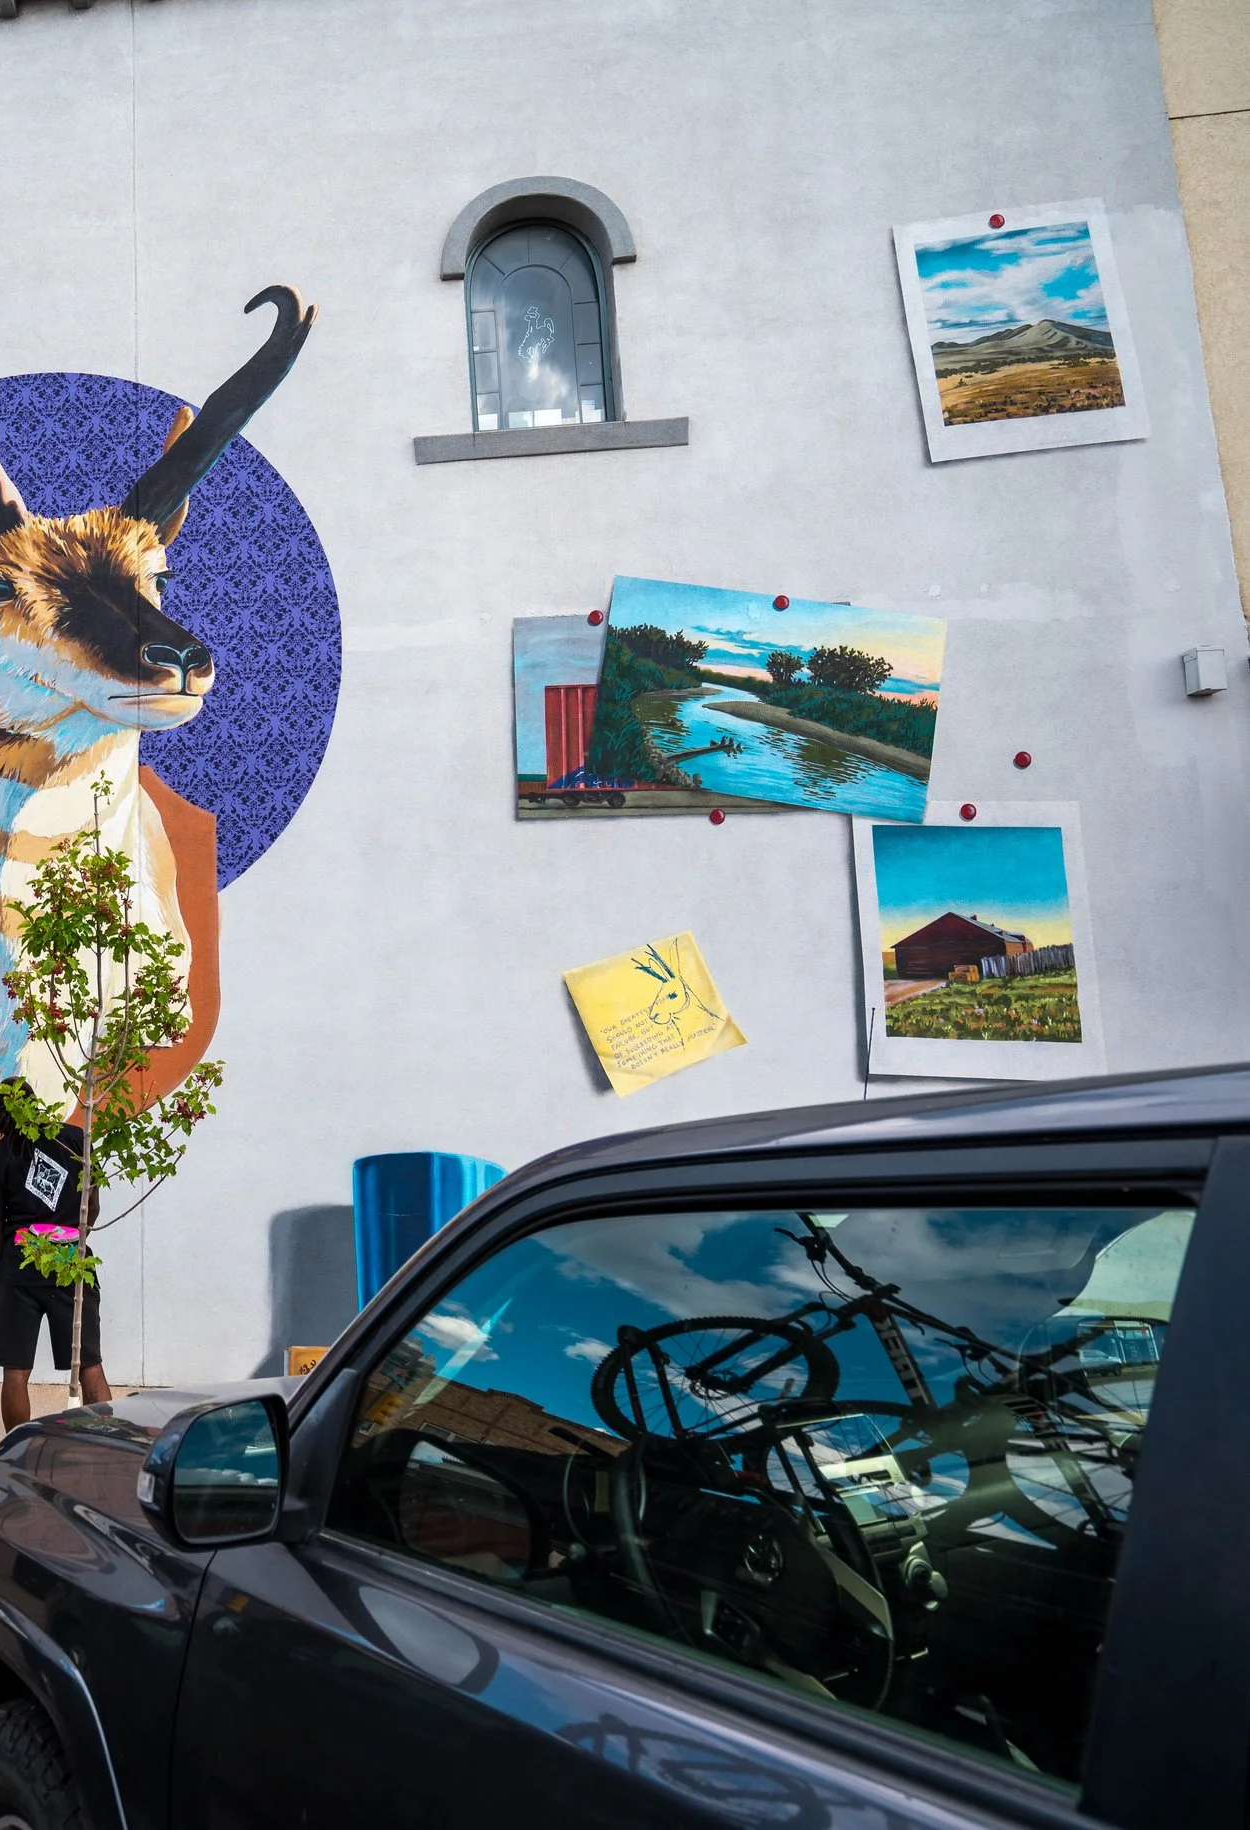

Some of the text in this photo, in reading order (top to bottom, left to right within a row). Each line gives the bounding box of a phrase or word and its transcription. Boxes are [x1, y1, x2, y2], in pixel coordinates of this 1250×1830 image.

[606, 1017, 650, 1044] SHOULD NOT
[614, 1023, 674, 1060] OF SUCCEEDING AT
[640, 1024, 655, 1036] BUT
[616, 1033, 676, 1068] SOMETHING THAT
[660, 1039, 685, 1056] REALLY
